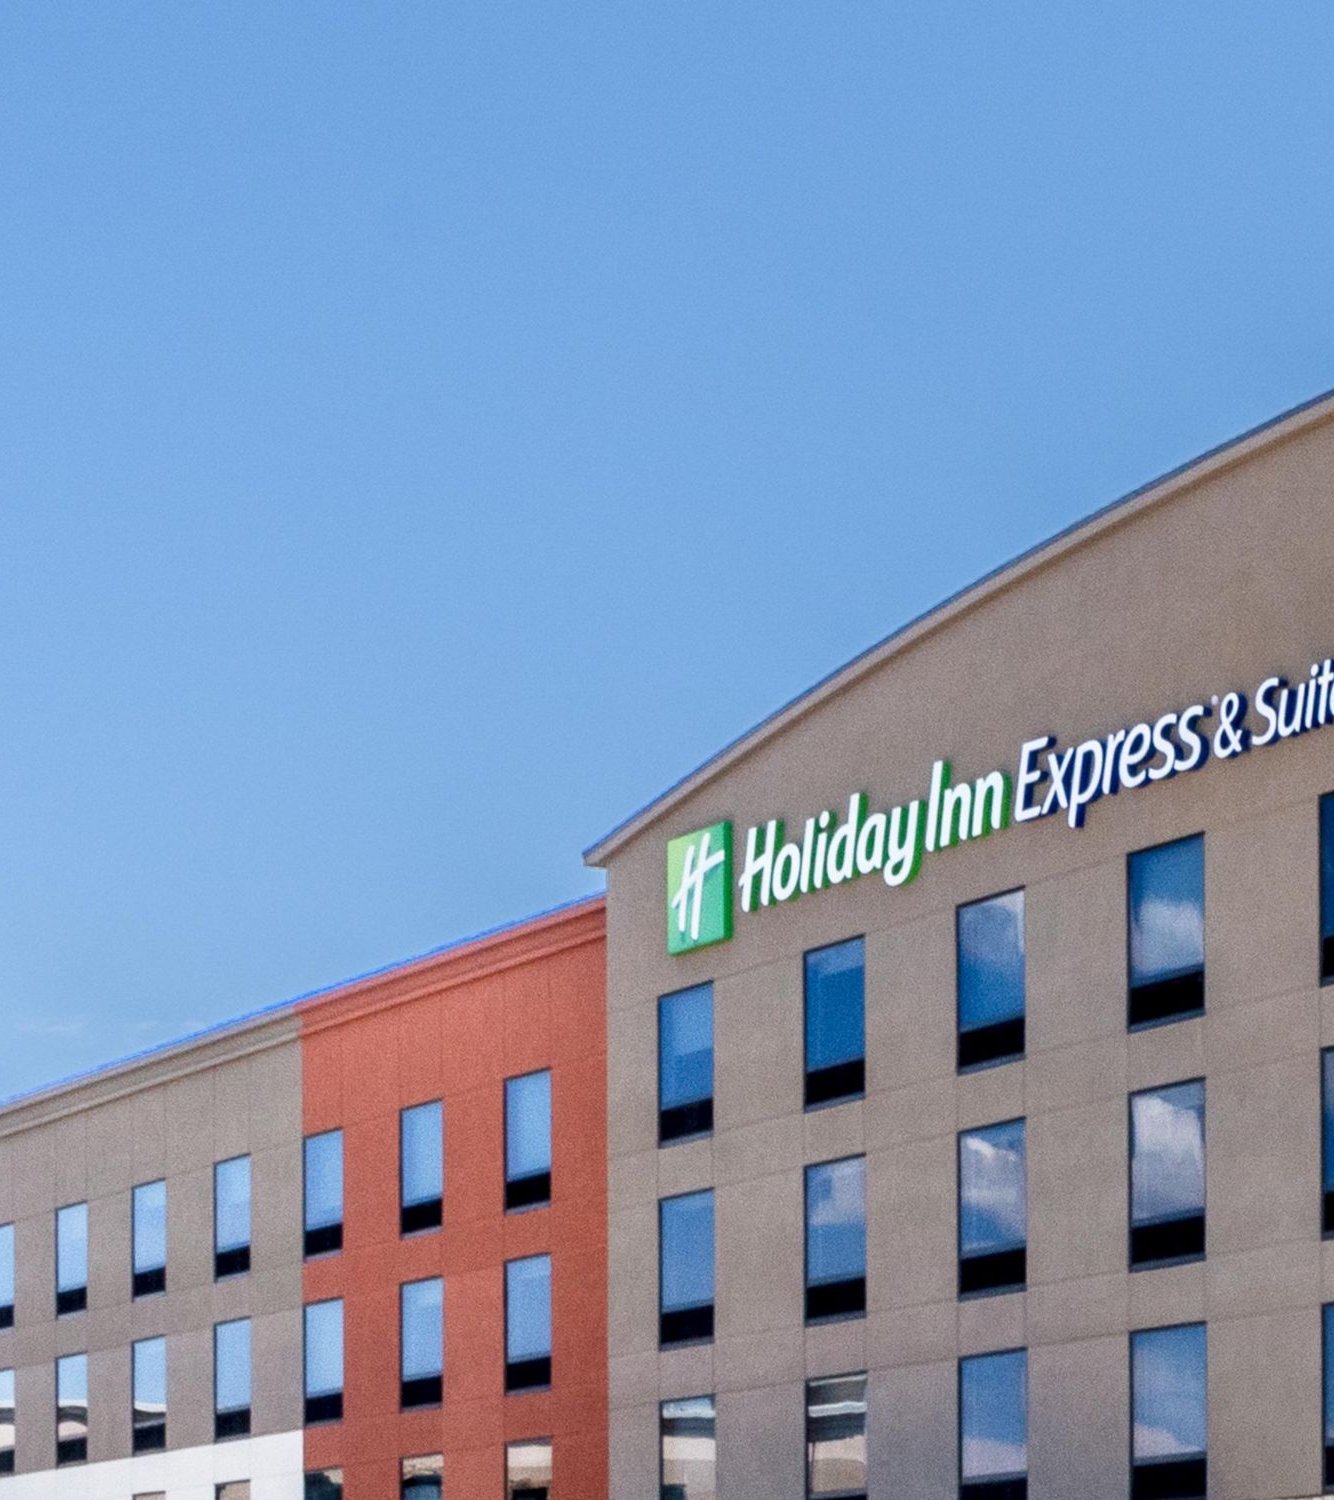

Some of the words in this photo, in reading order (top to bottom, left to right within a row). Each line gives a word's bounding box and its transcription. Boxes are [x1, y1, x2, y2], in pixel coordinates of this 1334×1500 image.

[738, 792, 921, 913] Holiday
[925, 760, 1006, 852] Inn
[1014, 705, 1208, 829] Express
[1213, 692, 1245, 759] &
